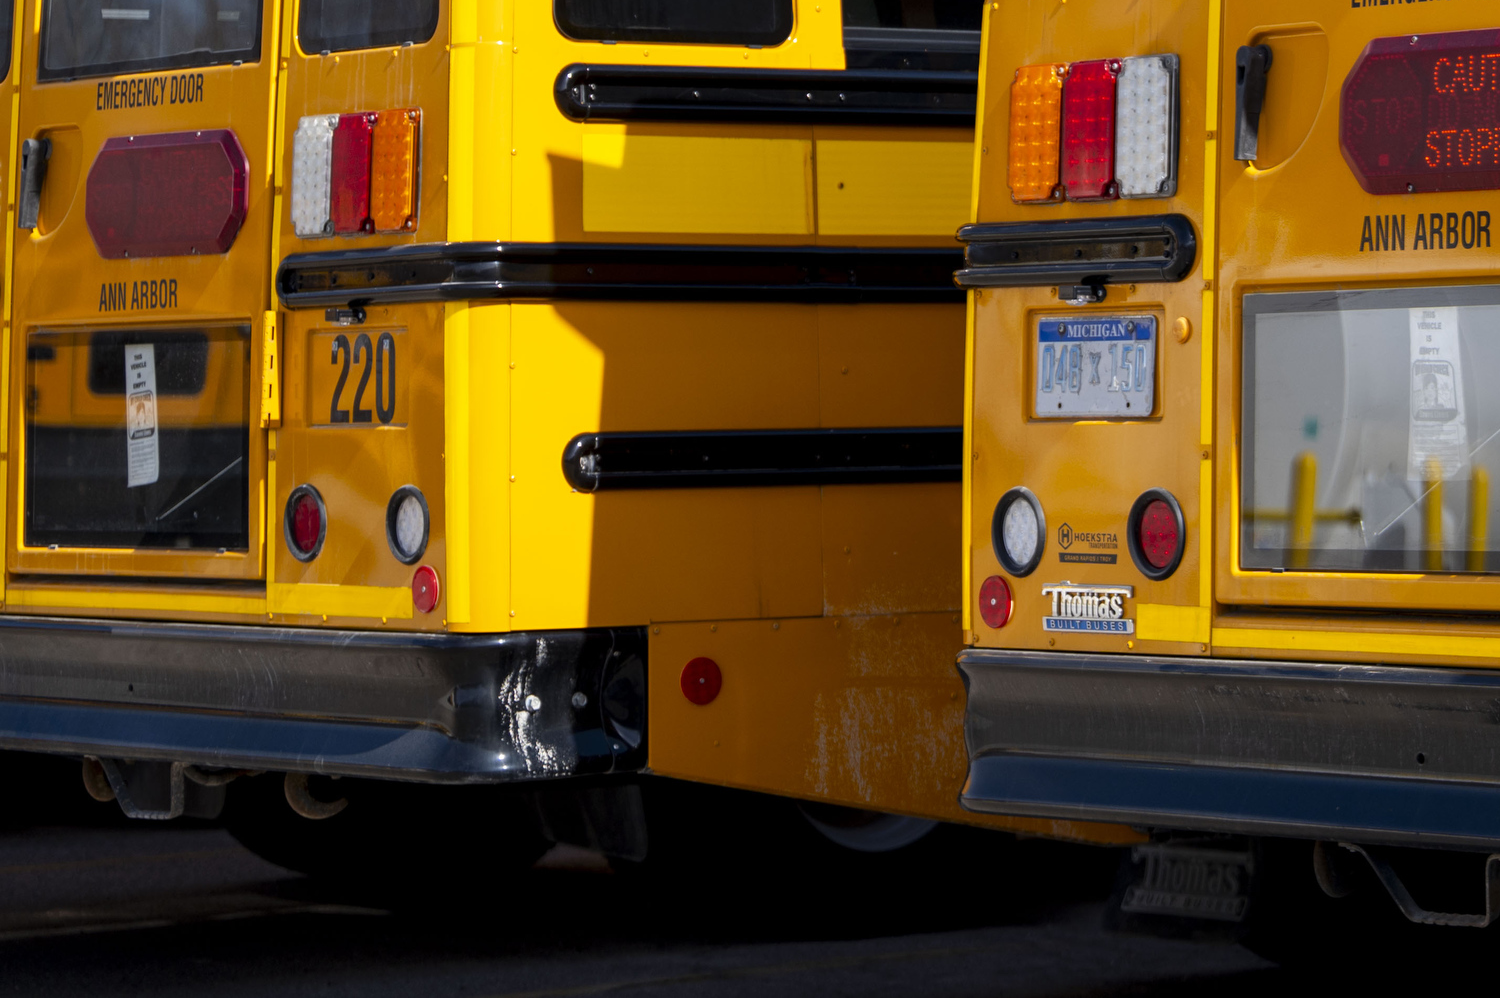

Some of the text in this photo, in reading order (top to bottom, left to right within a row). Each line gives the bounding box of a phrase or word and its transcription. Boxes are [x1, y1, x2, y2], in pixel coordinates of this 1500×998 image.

[97, 73, 204, 111] EMERGENCY DOOR
[1359, 210, 1491, 252] ANN ARBOR
[99, 279, 178, 312] ANN ARBOR
[1067, 323, 1125, 338] MICHIGAN
[330, 332, 395, 424] 220
[1041, 343, 1082, 393] 048
[1074, 532, 1118, 542] HOEKSTRA
[1042, 585, 1131, 619] Thomas
[1050, 619, 1124, 631] BUILT BUSES
[1131, 846, 1254, 896] Thomas
